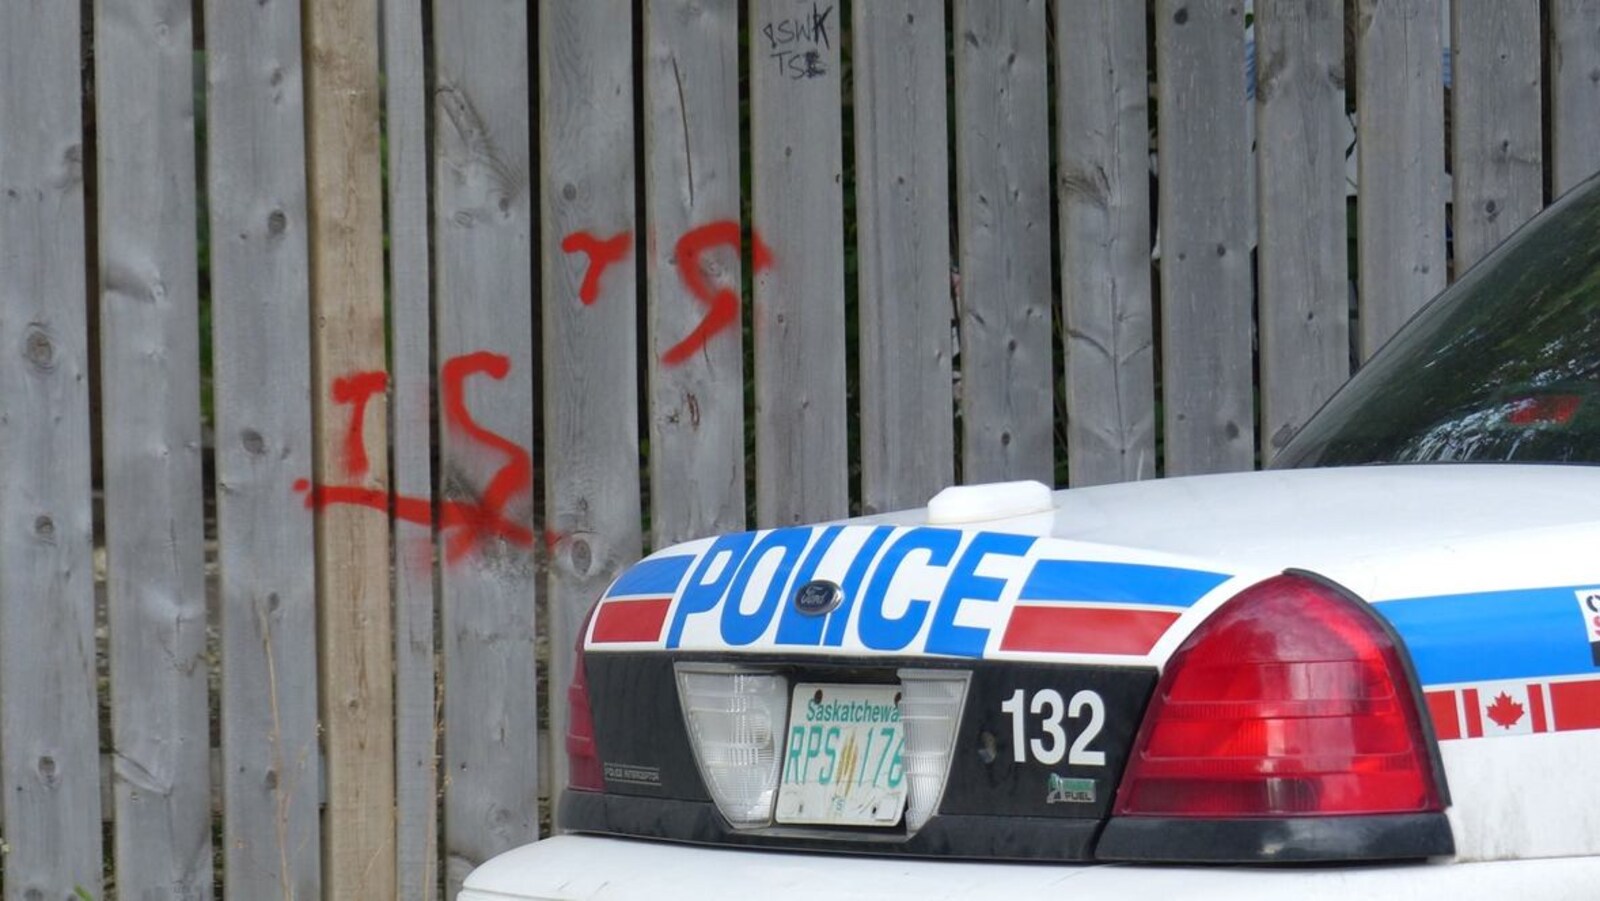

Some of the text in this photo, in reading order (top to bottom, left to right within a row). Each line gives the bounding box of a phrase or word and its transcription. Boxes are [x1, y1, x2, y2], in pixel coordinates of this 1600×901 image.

[666, 525, 1038, 659] POLICE
[806, 698, 902, 723] Saskatchewa
[1001, 688, 1106, 766] 132
[784, 725, 840, 785] RPS
